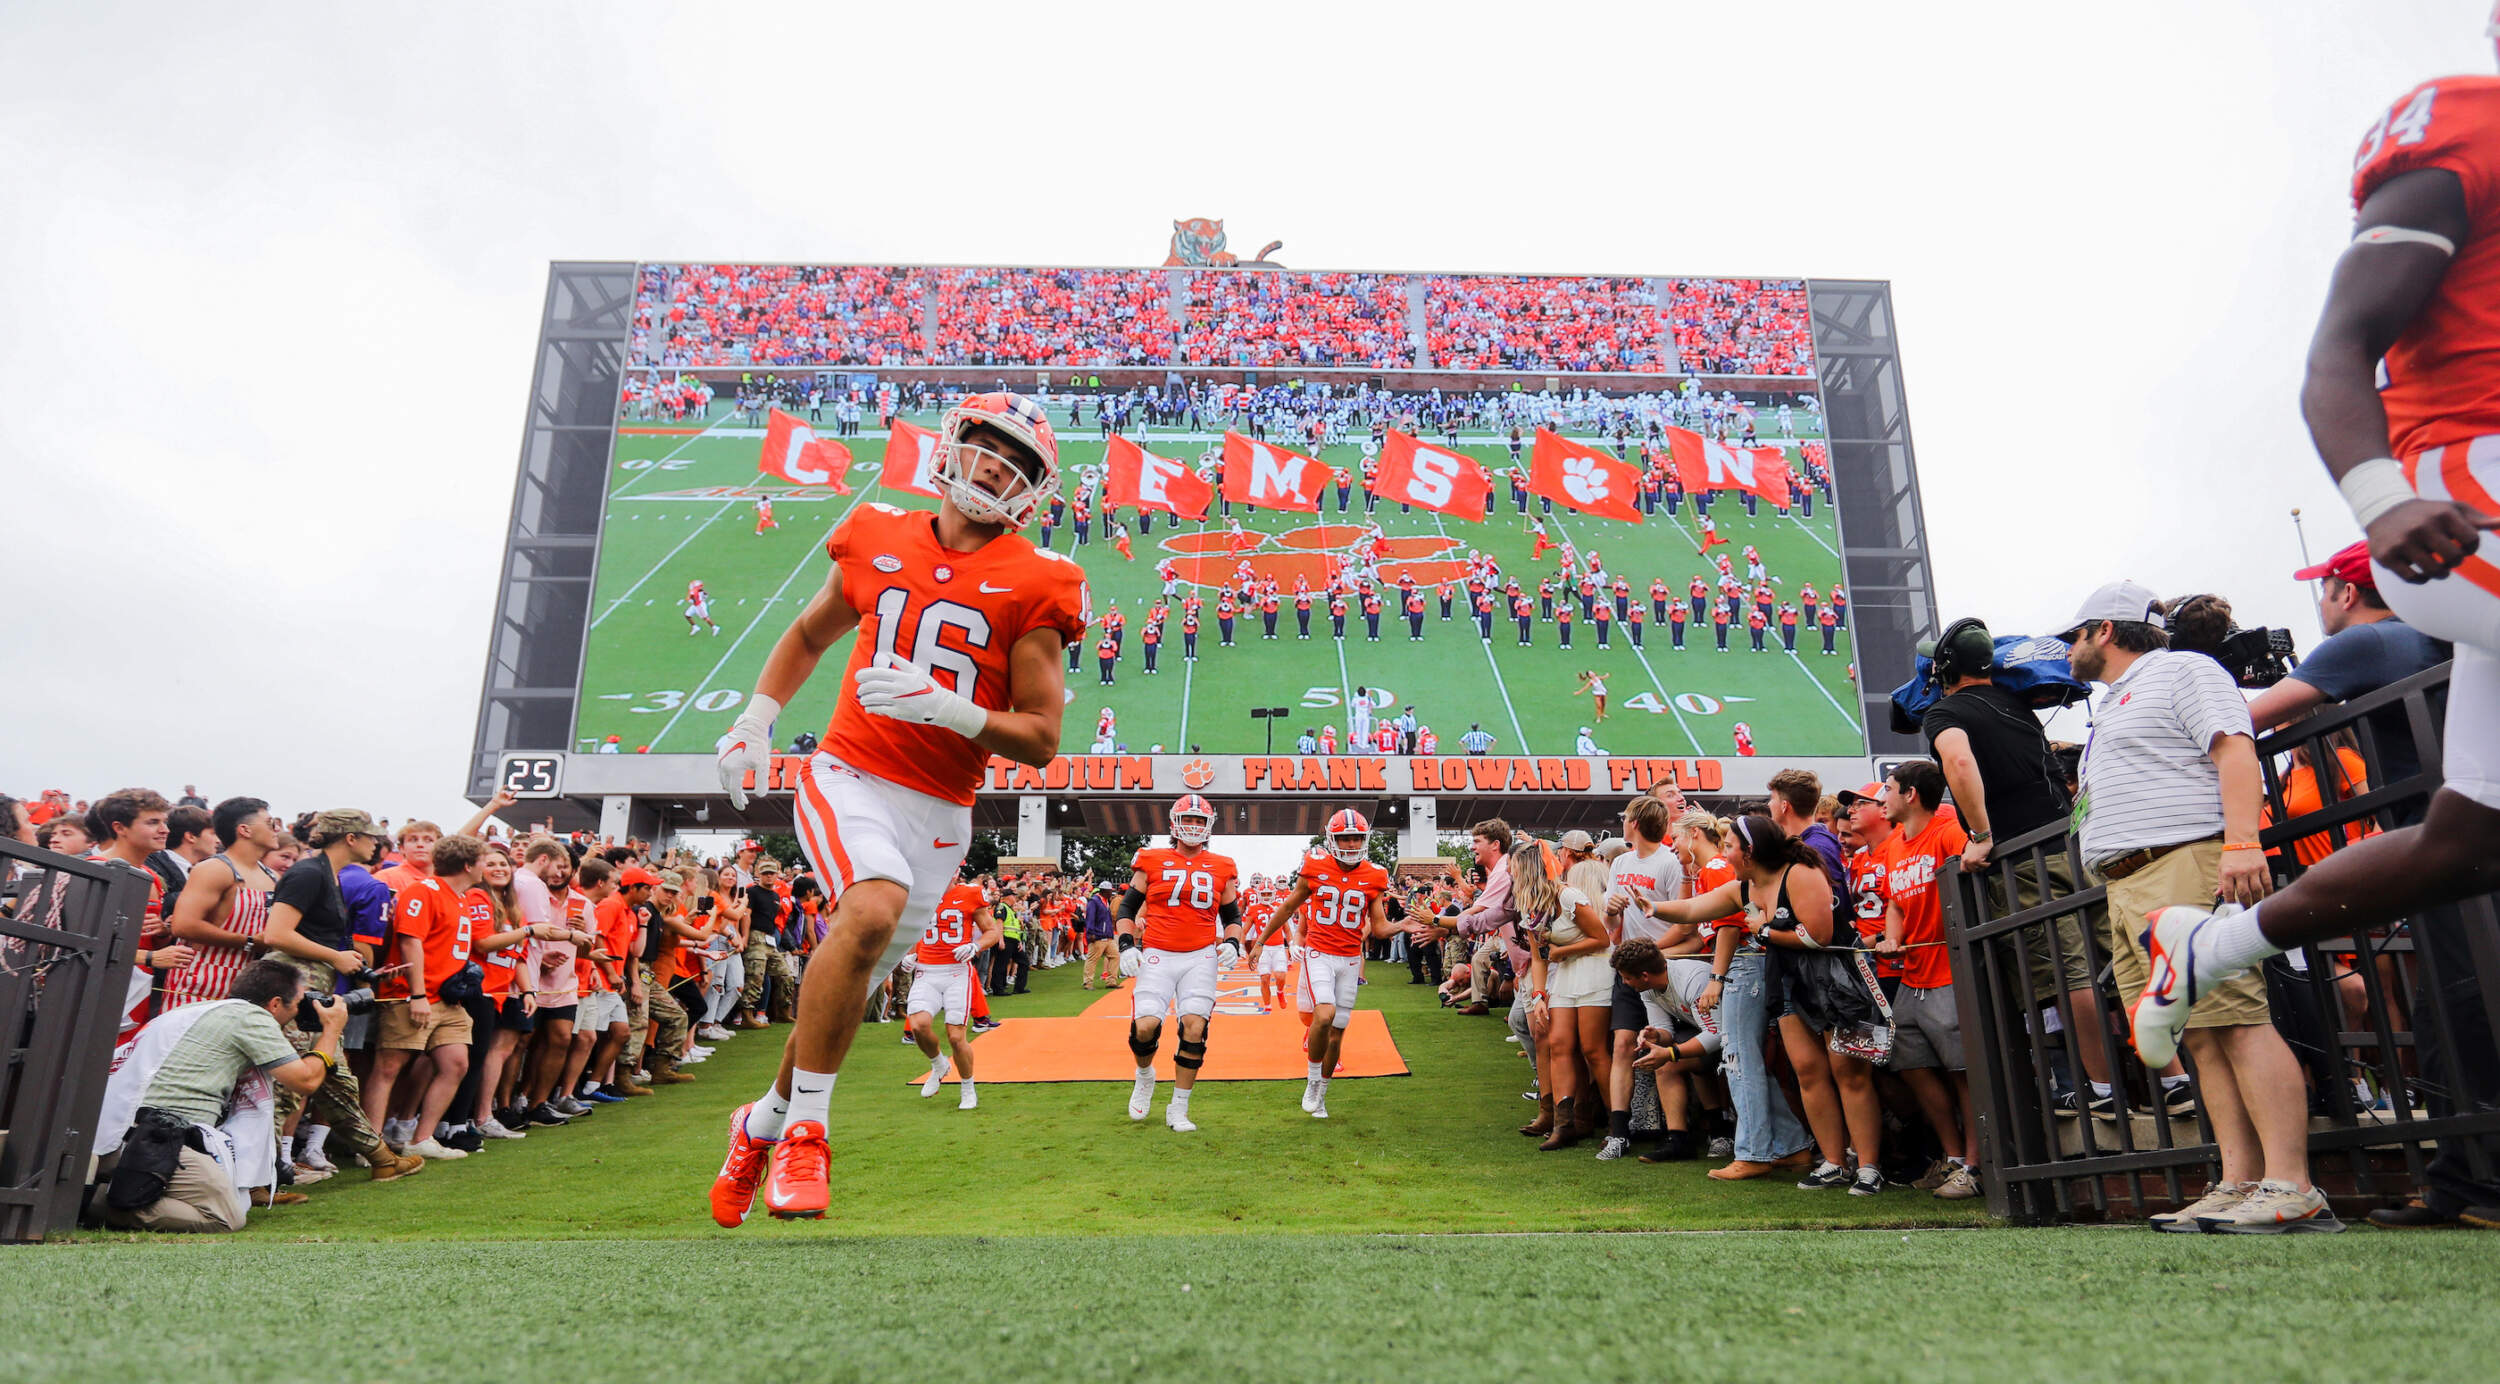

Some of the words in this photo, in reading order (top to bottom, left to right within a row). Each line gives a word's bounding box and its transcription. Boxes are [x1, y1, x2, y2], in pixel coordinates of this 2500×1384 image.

[2354, 86, 2438, 172] 34
[784, 425, 831, 485] C
[1139, 448, 1184, 510] E
[1250, 442, 1307, 504] M
[1406, 447, 1460, 507] S
[1703, 440, 1757, 488] N
[857, 586, 992, 702] 16
[629, 689, 744, 714] 30
[1623, 692, 1723, 715] 40
[507, 760, 552, 791] 25
[975, 756, 1153, 789] TADIUM
[1243, 758, 1387, 790] FRANK
[1410, 758, 1591, 790] HOWARD
[1607, 759, 1724, 791] FIELD
[1162, 869, 1214, 910] 78
[406, 899, 423, 918] 9
[470, 904, 491, 921] 25
[1315, 885, 1366, 930] 38
[452, 915, 472, 961] 9
[1857, 959, 1878, 994] TIGERS
